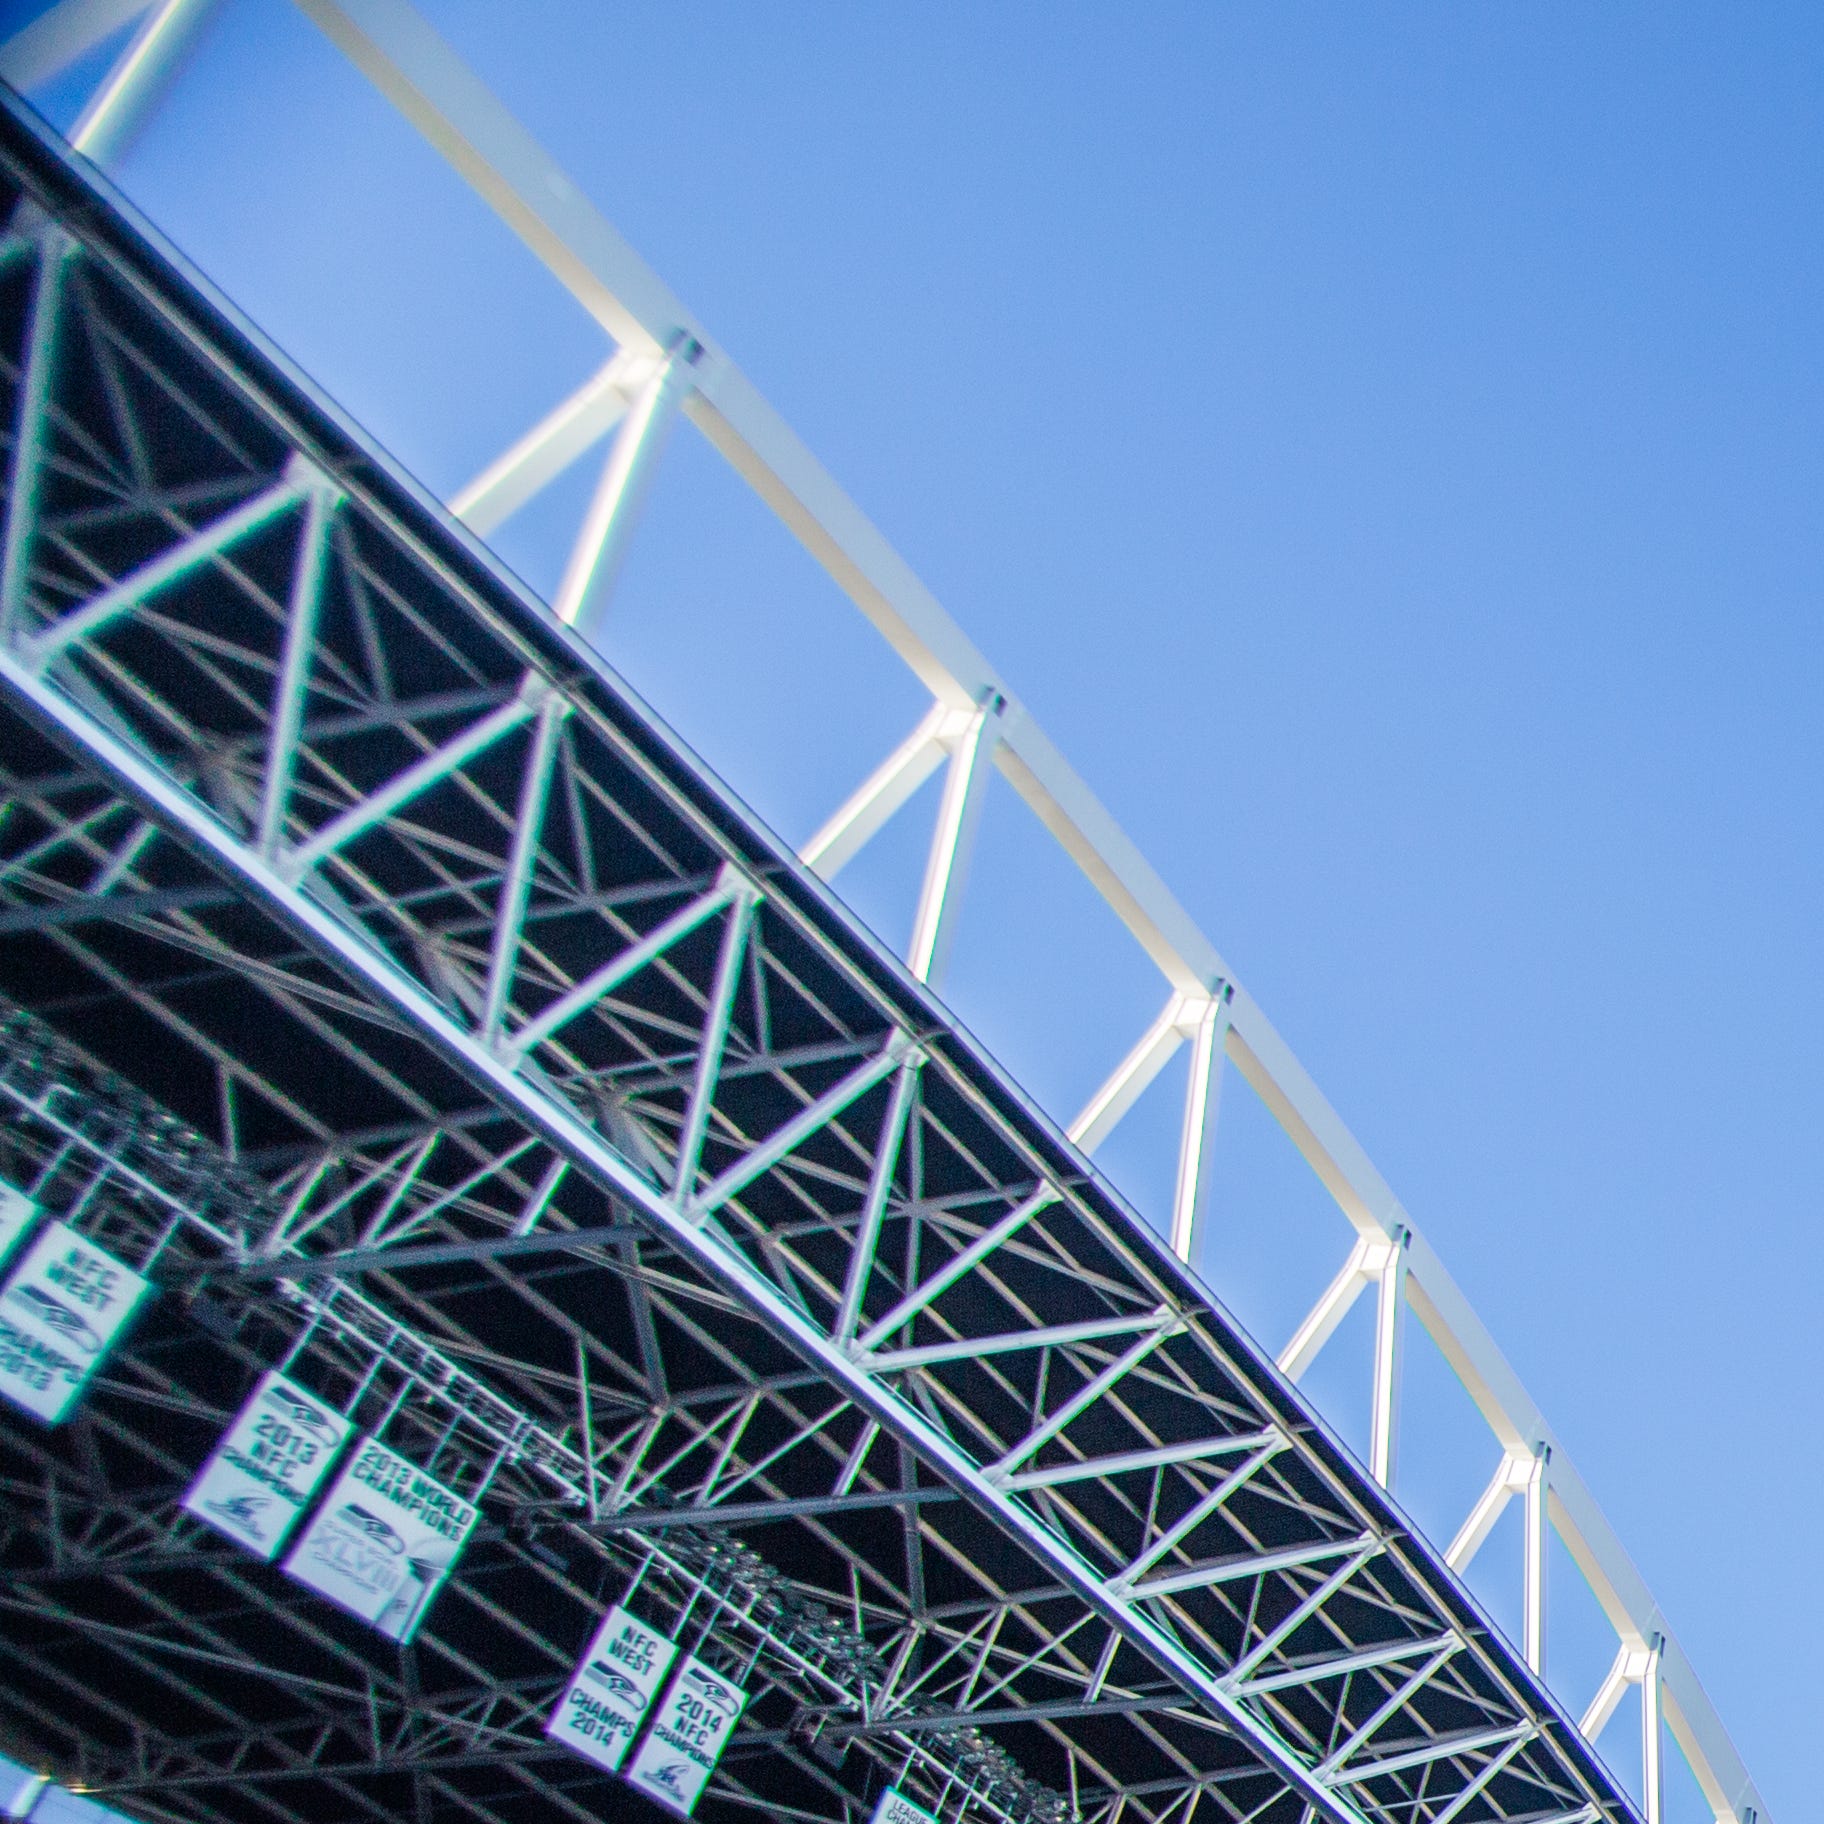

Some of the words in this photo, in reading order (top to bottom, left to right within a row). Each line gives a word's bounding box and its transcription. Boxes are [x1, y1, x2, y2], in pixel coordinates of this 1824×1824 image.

[255, 1414, 319, 1464] 2013
[251, 1442, 296, 1478] NFC
[351, 1462, 466, 1541] CHAMPIONS
[362, 1445, 412, 1486] 2013
[411, 1474, 473, 1526] WORLD
[608, 1638, 656, 1676] WEST
[622, 1625, 658, 1658] NFC
[568, 1688, 637, 1738] CHAMPS
[570, 1711, 615, 1747] 2014
[673, 1717, 709, 1747] NFC
[676, 1693, 723, 1733] 2014
[654, 1723, 716, 1770] CHAMPIONS
